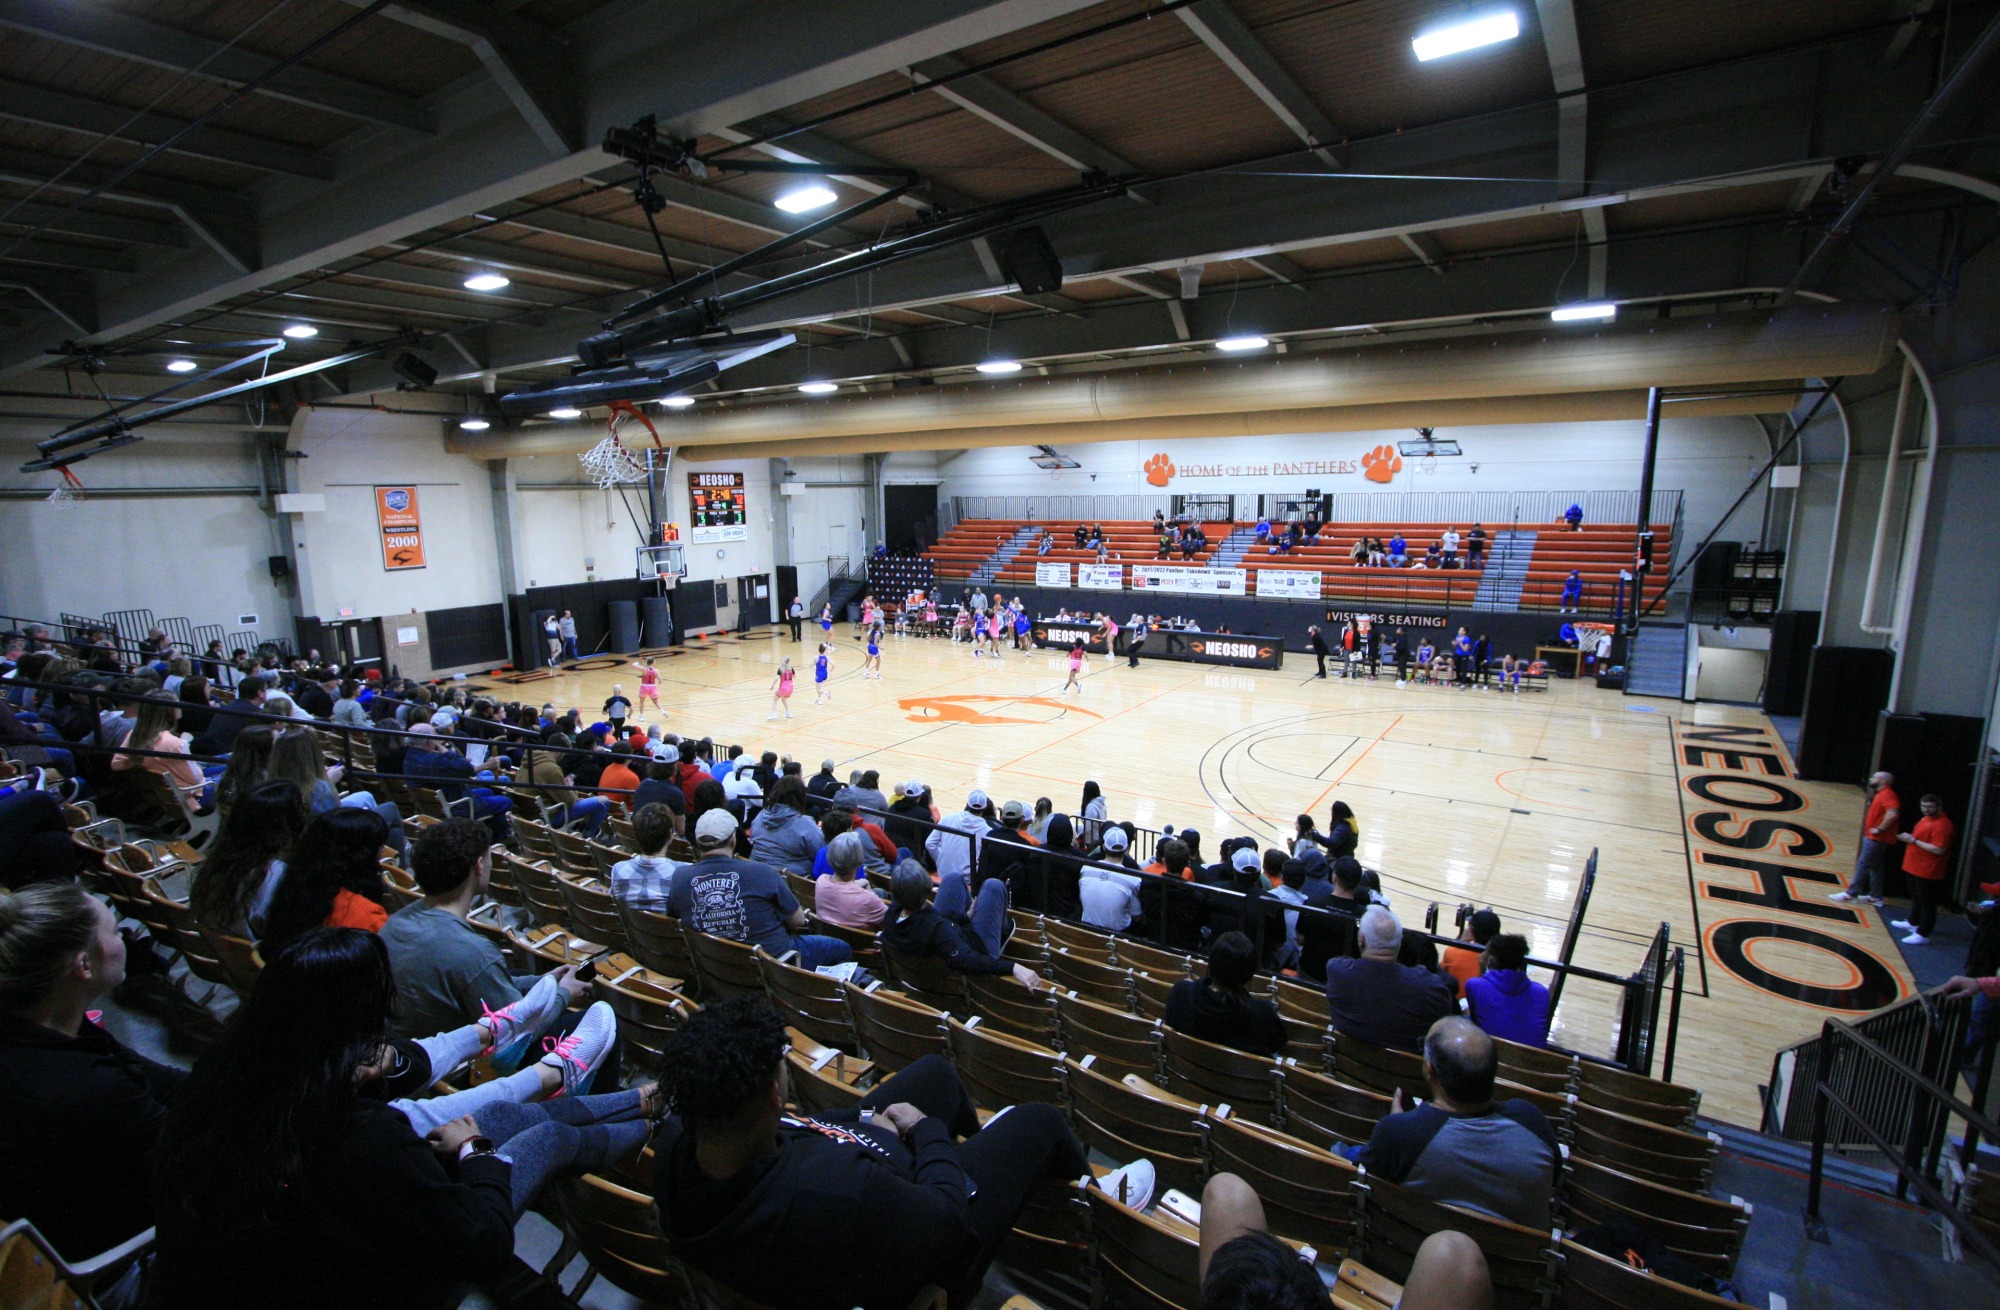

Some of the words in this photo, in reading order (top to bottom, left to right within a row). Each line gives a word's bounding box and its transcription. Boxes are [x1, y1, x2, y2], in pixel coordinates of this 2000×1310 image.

[1180, 465, 1224, 477] HOME
[1225, 466, 1241, 476] OF
[1246, 465, 1269, 476] THE
[1273, 460, 1357, 475] PANTHERS
[700, 474, 734, 486] NEOSHO
[387, 536, 418, 548] 2000
[1389, 614, 1442, 628] SEATING
[1205, 641, 1257, 659] NEOSHO
[1675, 719, 1910, 1016] NEOSHO
[694, 878, 737, 894] MONTEREY
[701, 910, 736, 920] CALIFORNIA
[703, 918, 736, 928] REPUBLIC
